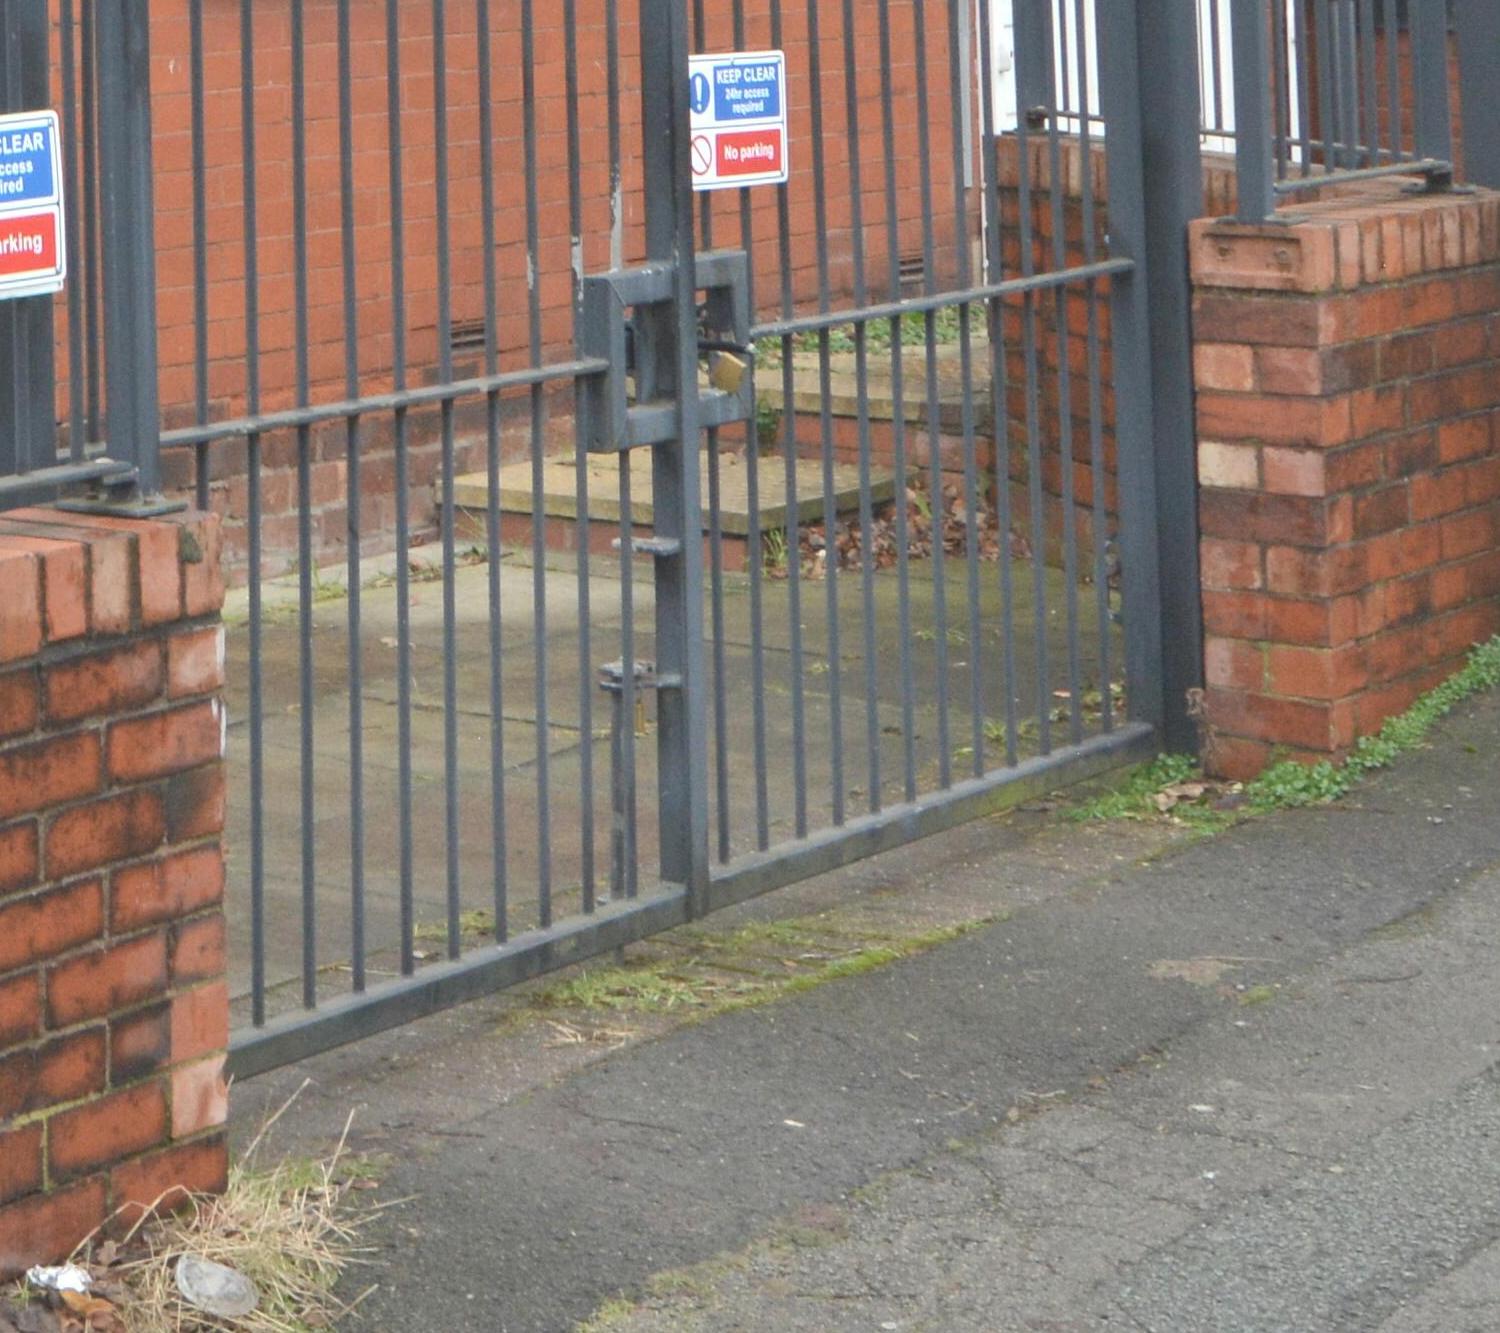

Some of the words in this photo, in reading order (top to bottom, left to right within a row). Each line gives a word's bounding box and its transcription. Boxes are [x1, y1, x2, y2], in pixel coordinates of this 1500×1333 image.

[716, 69, 742, 85] KEEP
[743, 66, 777, 82] CLEAR
[725, 89, 743, 101] 24hr
[743, 88, 770, 100] access
[732, 100, 765, 116] required
[724, 145, 738, 161] No
[740, 142, 774, 163] parking
